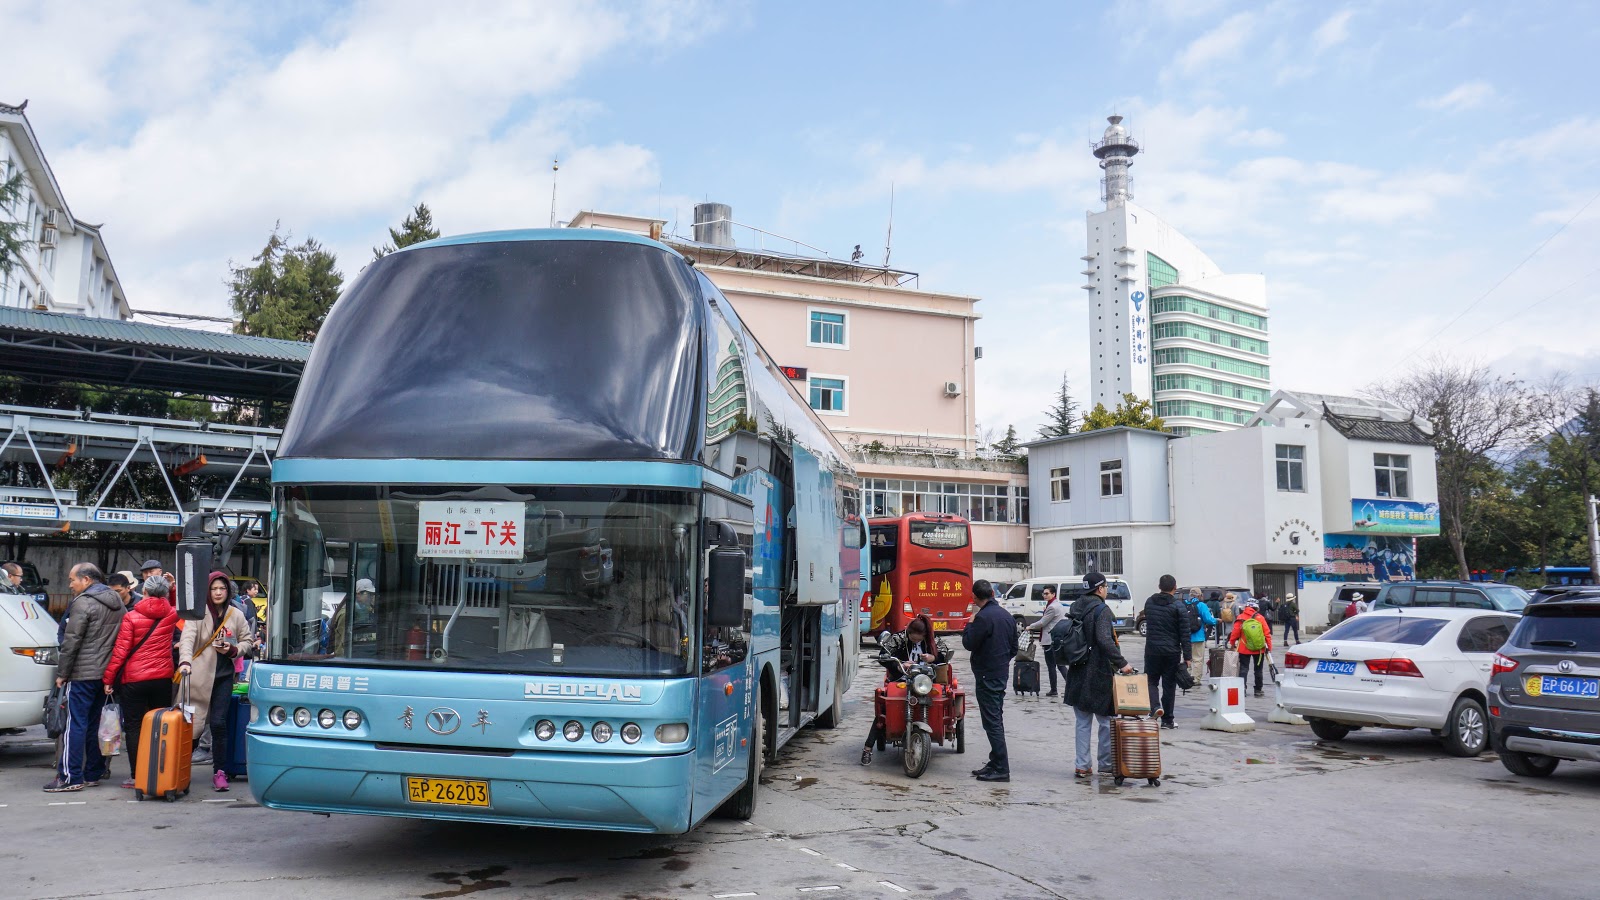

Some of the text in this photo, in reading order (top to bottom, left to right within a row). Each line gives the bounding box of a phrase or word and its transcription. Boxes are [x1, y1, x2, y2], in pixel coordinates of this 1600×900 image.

[270, 672, 369, 691] 德国尼奥普兰
[524, 682, 642, 702] NEOPLAN
